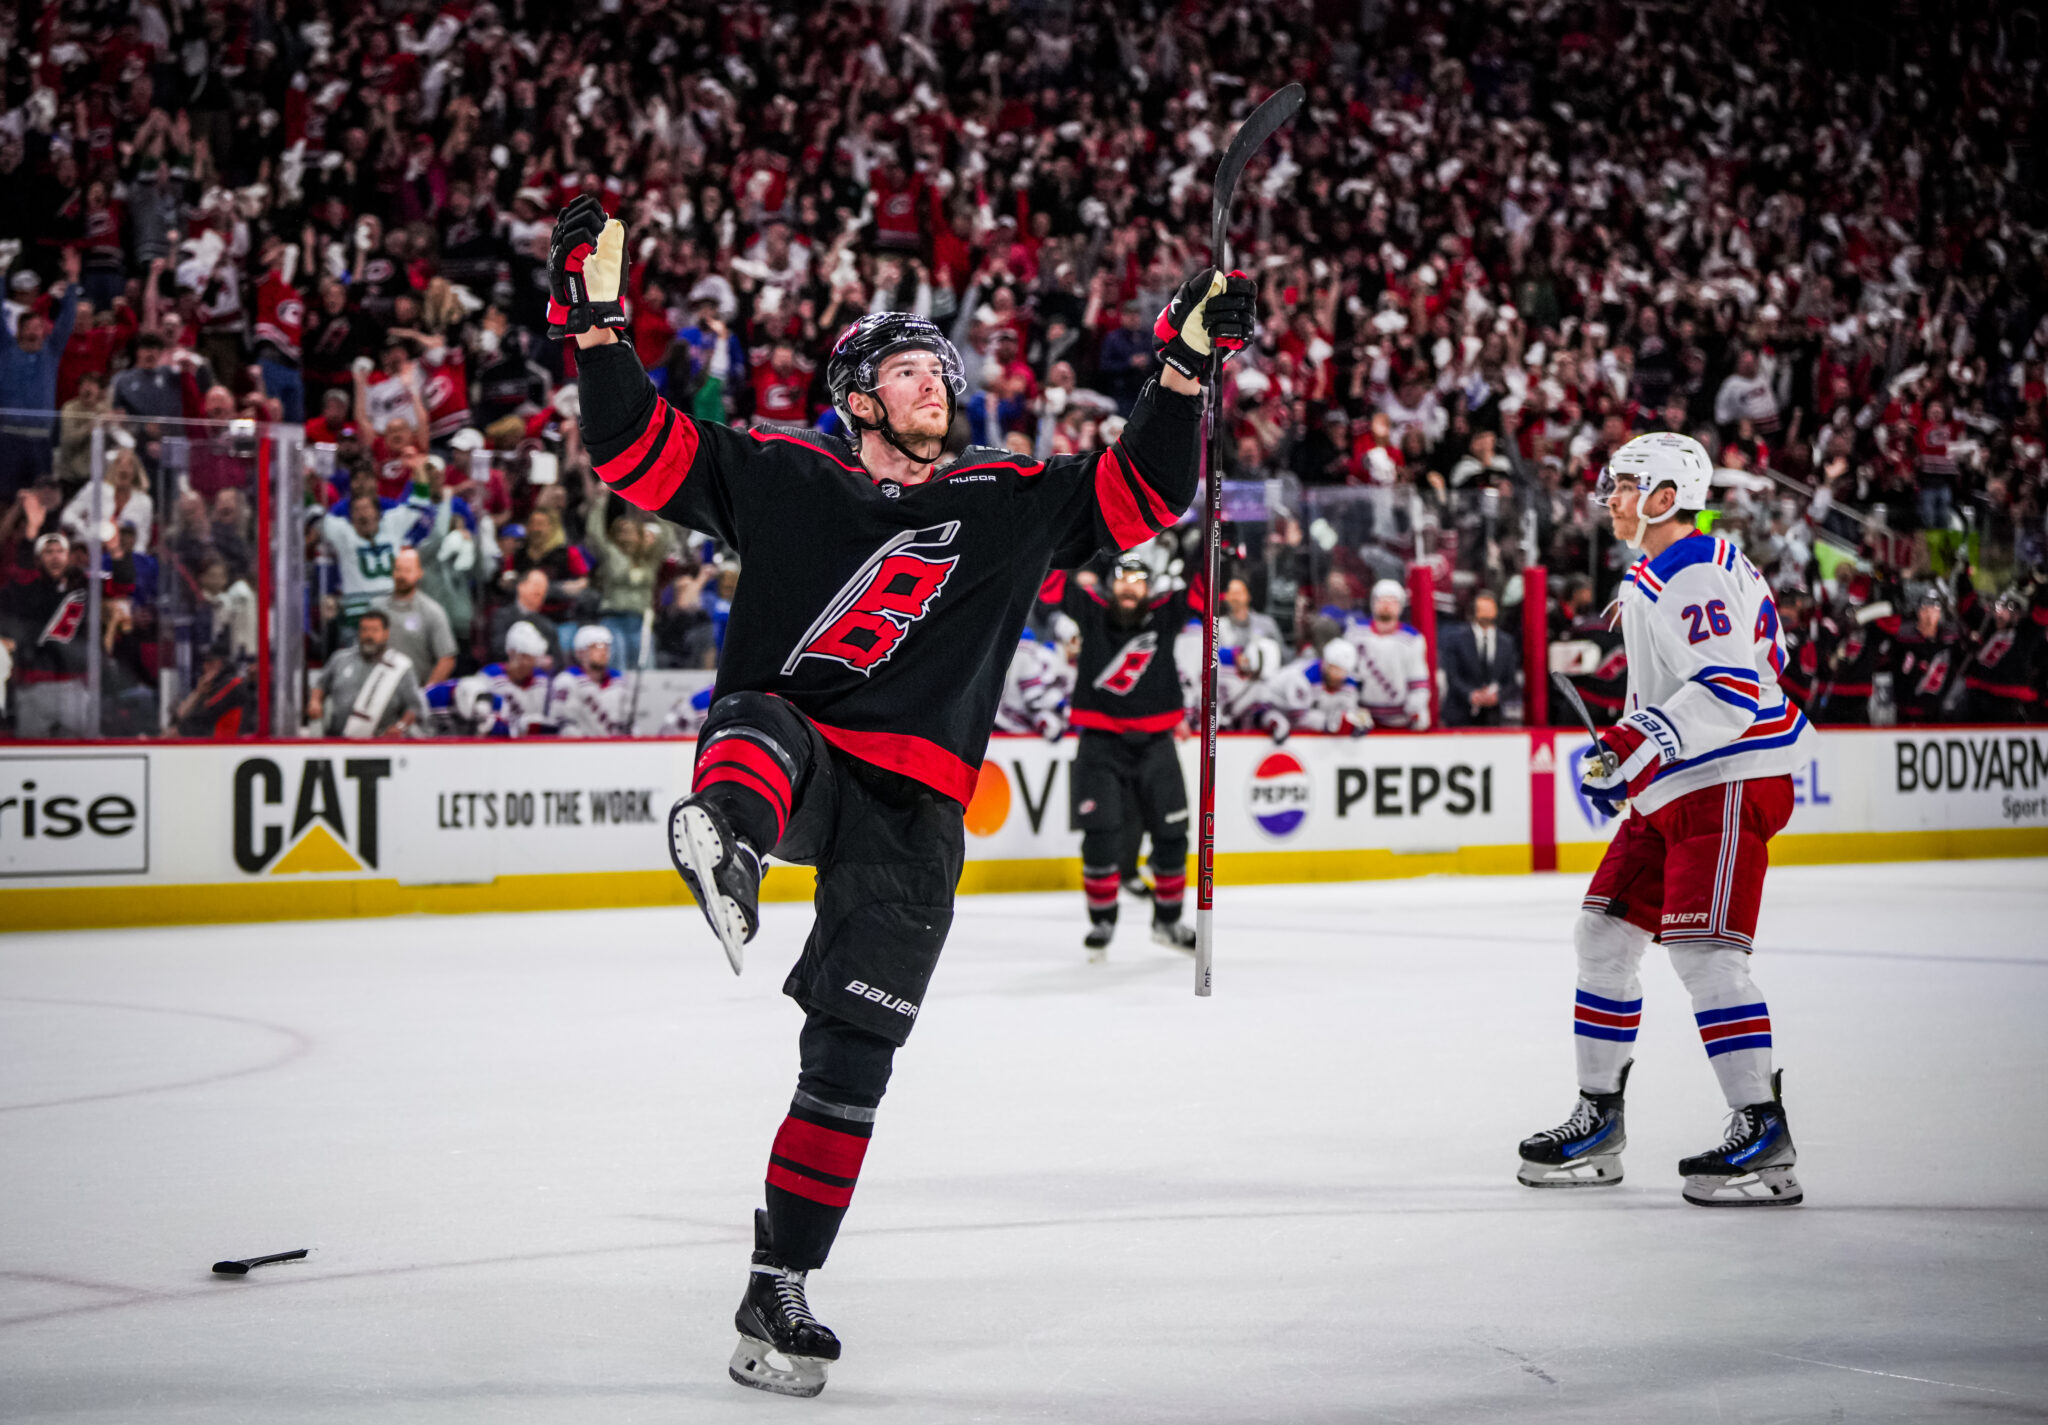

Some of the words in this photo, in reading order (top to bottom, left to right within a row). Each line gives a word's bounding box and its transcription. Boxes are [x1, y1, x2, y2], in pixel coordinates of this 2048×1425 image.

[949, 475, 997, 485] NUCOR
[1680, 599, 1732, 646] 26
[505, 791, 535, 828] DO
[542, 789, 582, 826] THE
[1336, 764, 1493, 818] PEPSI
[233, 757, 392, 875] CAT
[844, 979, 919, 1020] BAUER
